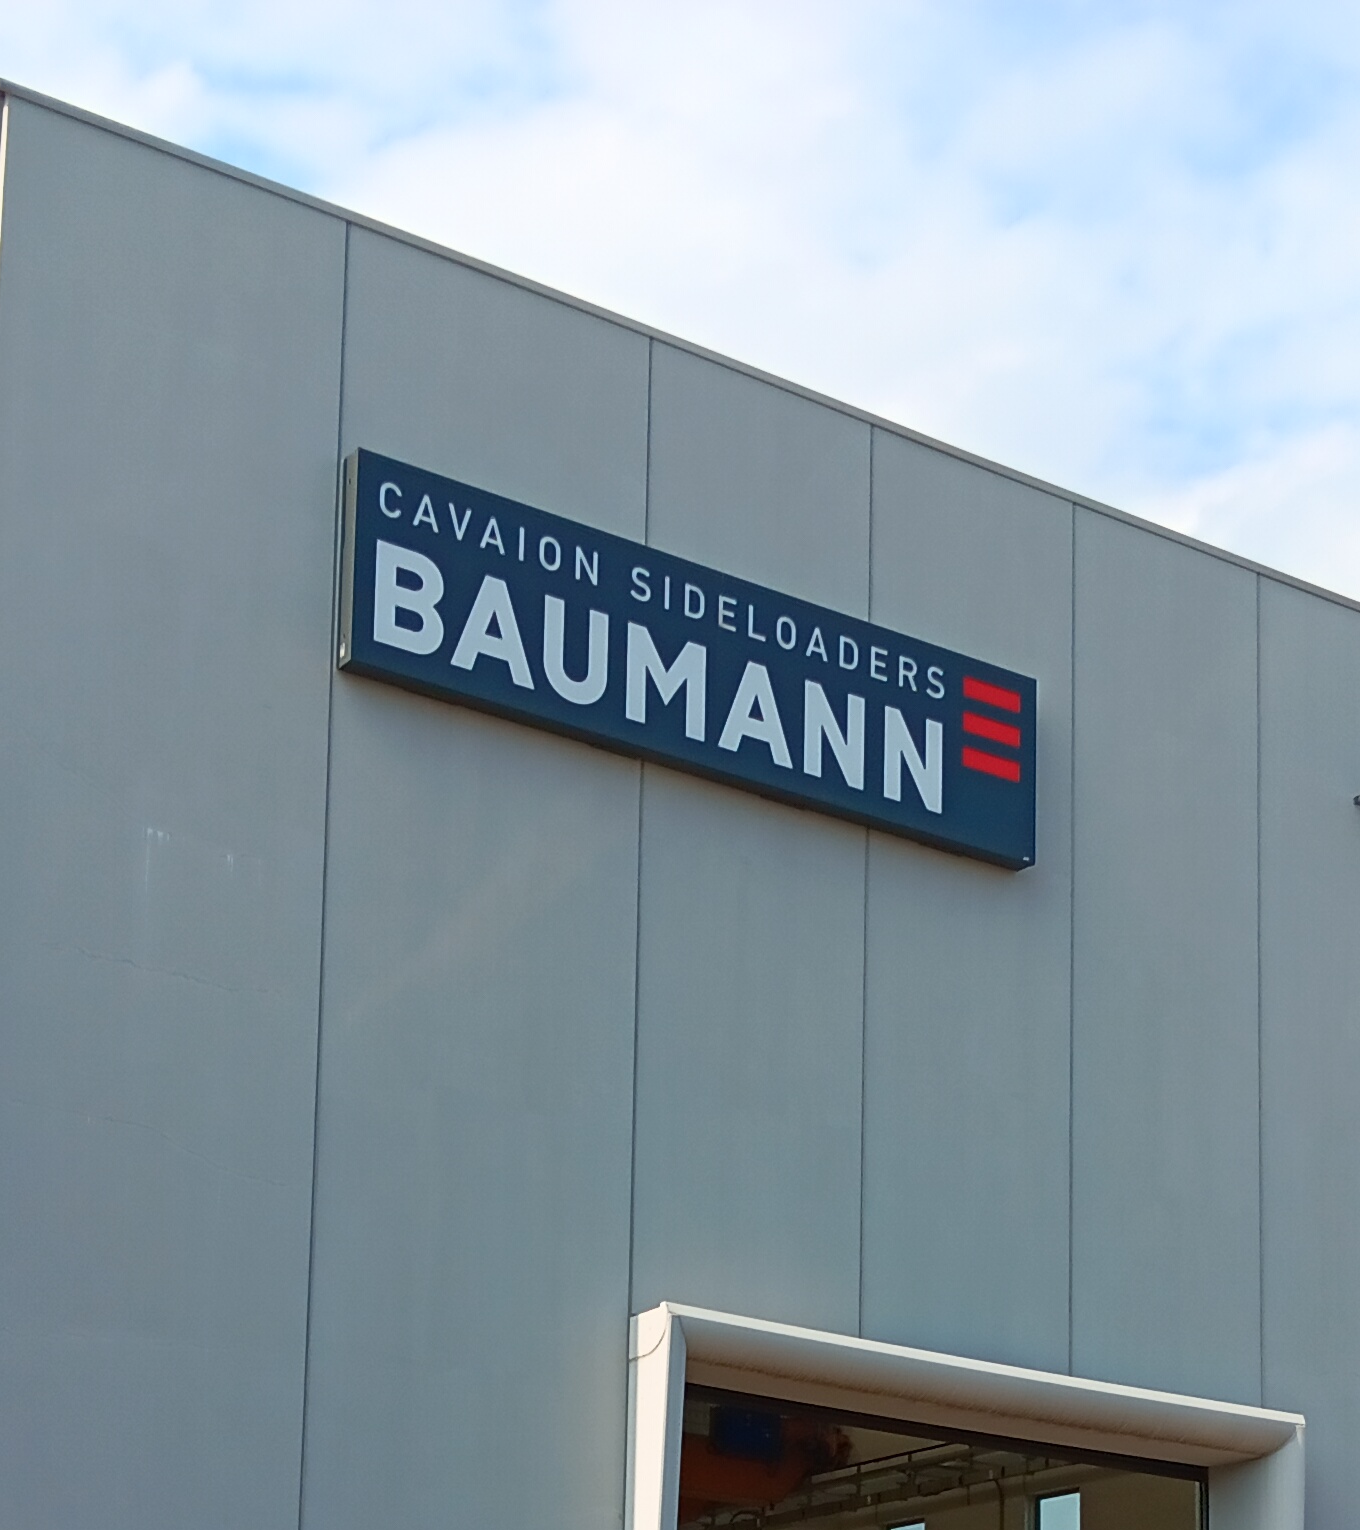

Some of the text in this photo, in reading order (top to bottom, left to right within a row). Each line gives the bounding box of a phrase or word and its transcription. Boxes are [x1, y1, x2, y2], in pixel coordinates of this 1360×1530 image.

[373, 539, 943, 815] BAUMANN
[378, 481, 946, 699] CAVAION SIDELOADERS
